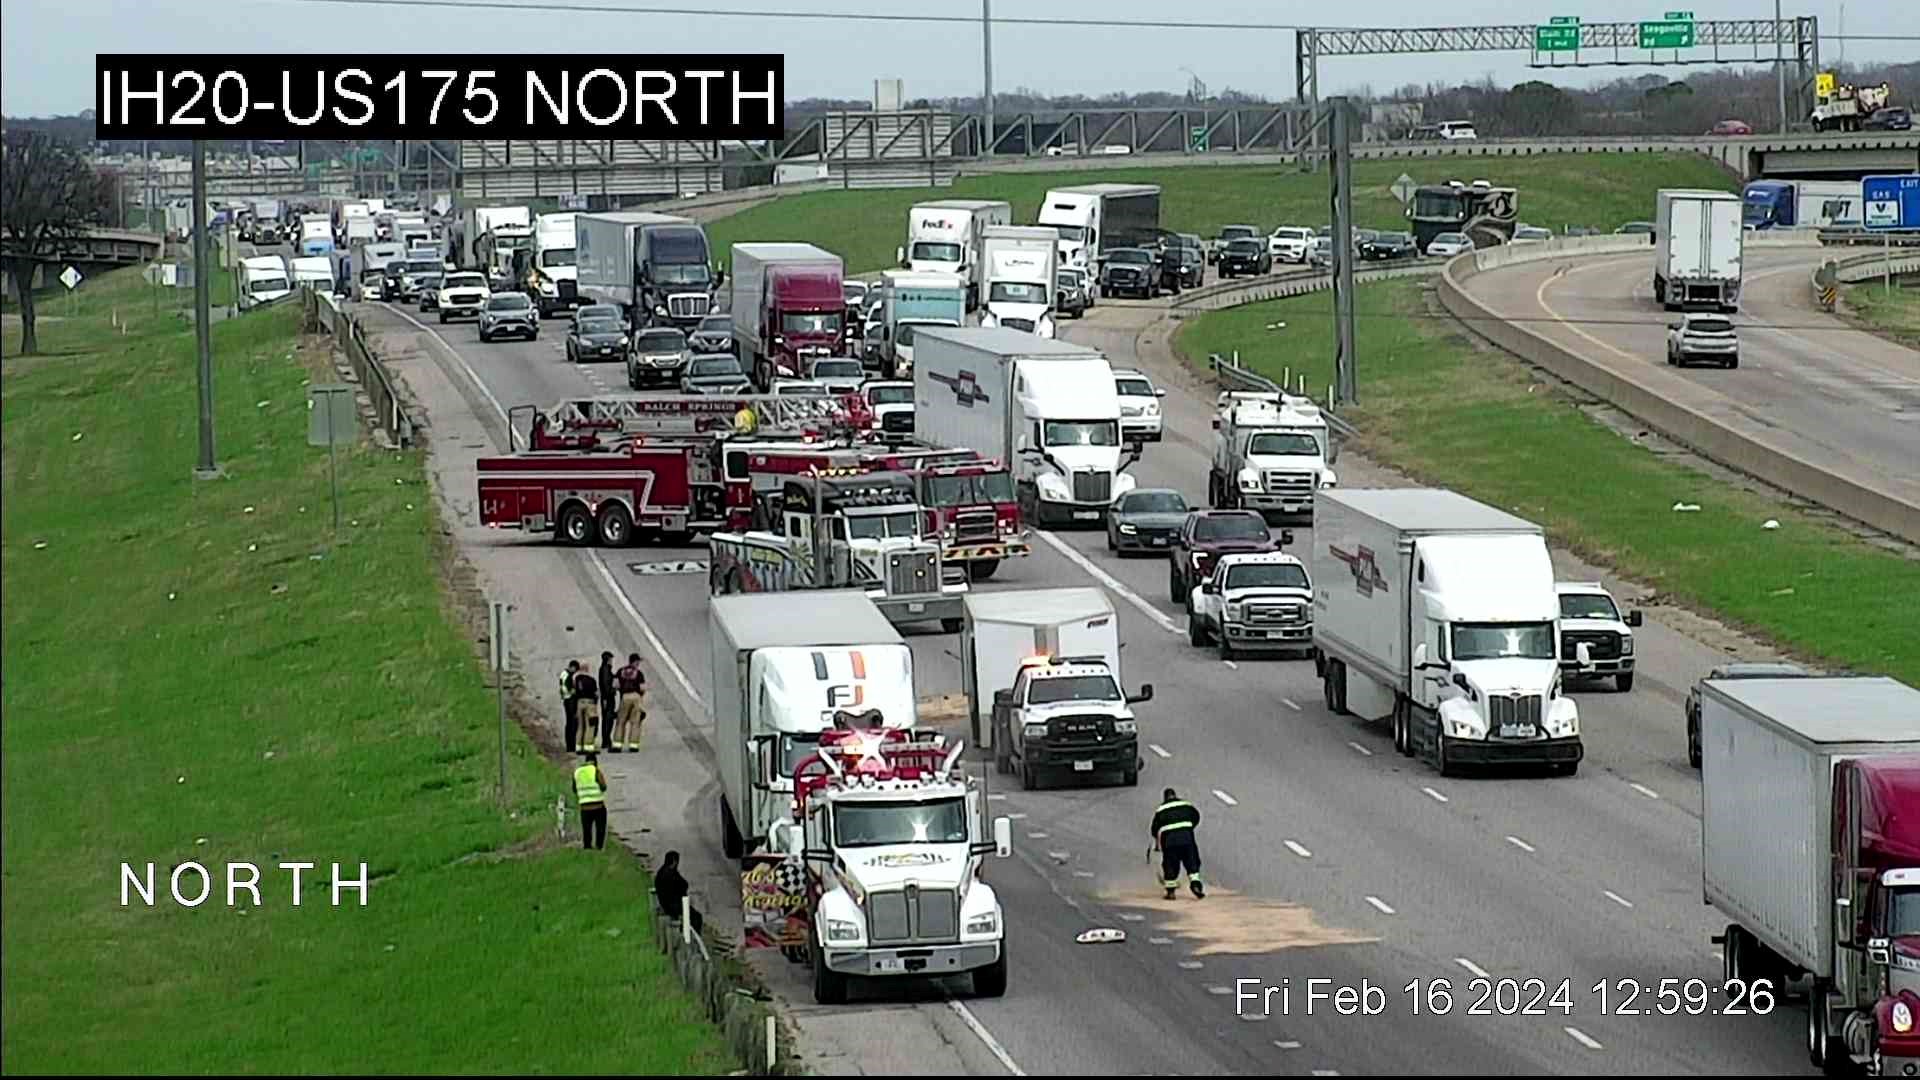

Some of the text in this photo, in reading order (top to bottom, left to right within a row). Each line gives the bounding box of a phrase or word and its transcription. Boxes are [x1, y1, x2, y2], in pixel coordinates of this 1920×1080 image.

[1872, 191, 1891, 200] GAS
[644, 402, 736, 411] BALCH SPRINGS
